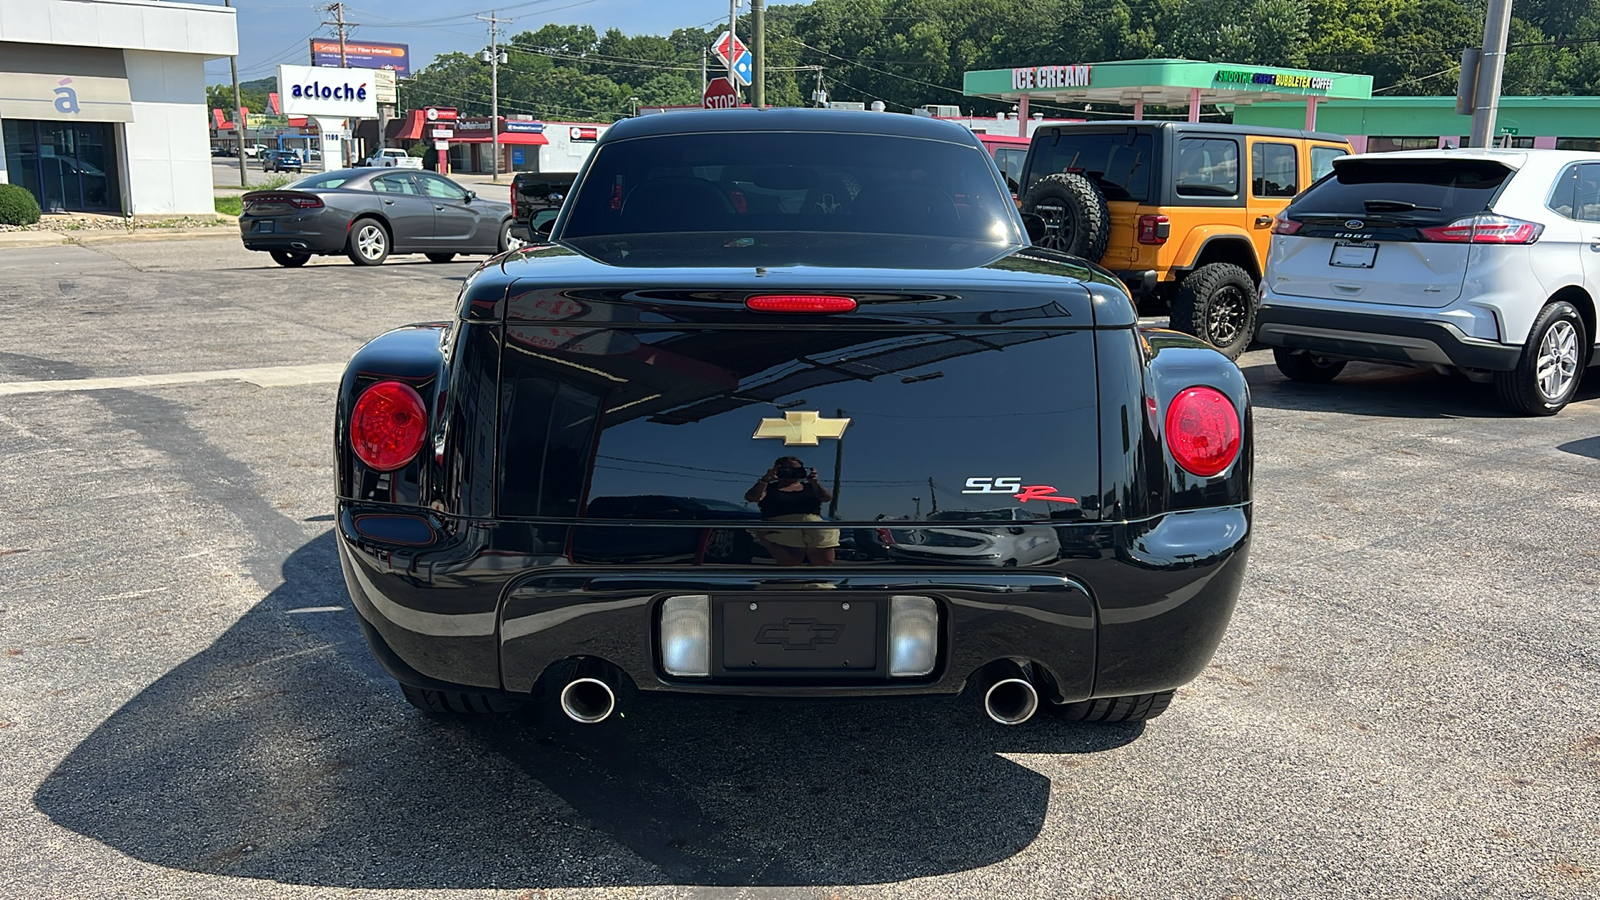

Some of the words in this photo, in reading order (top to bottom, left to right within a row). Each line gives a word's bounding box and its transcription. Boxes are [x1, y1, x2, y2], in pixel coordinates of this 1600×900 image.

[1012, 67, 1035, 90] ICE
[1037, 65, 1091, 88] CREAM
[1218, 70, 1253, 83] SMOOTHIE
[1312, 77, 1333, 90] COFFEE
[292, 81, 367, 100] acloché
[706, 94, 735, 109] STOP
[961, 477, 1078, 503] SSR
